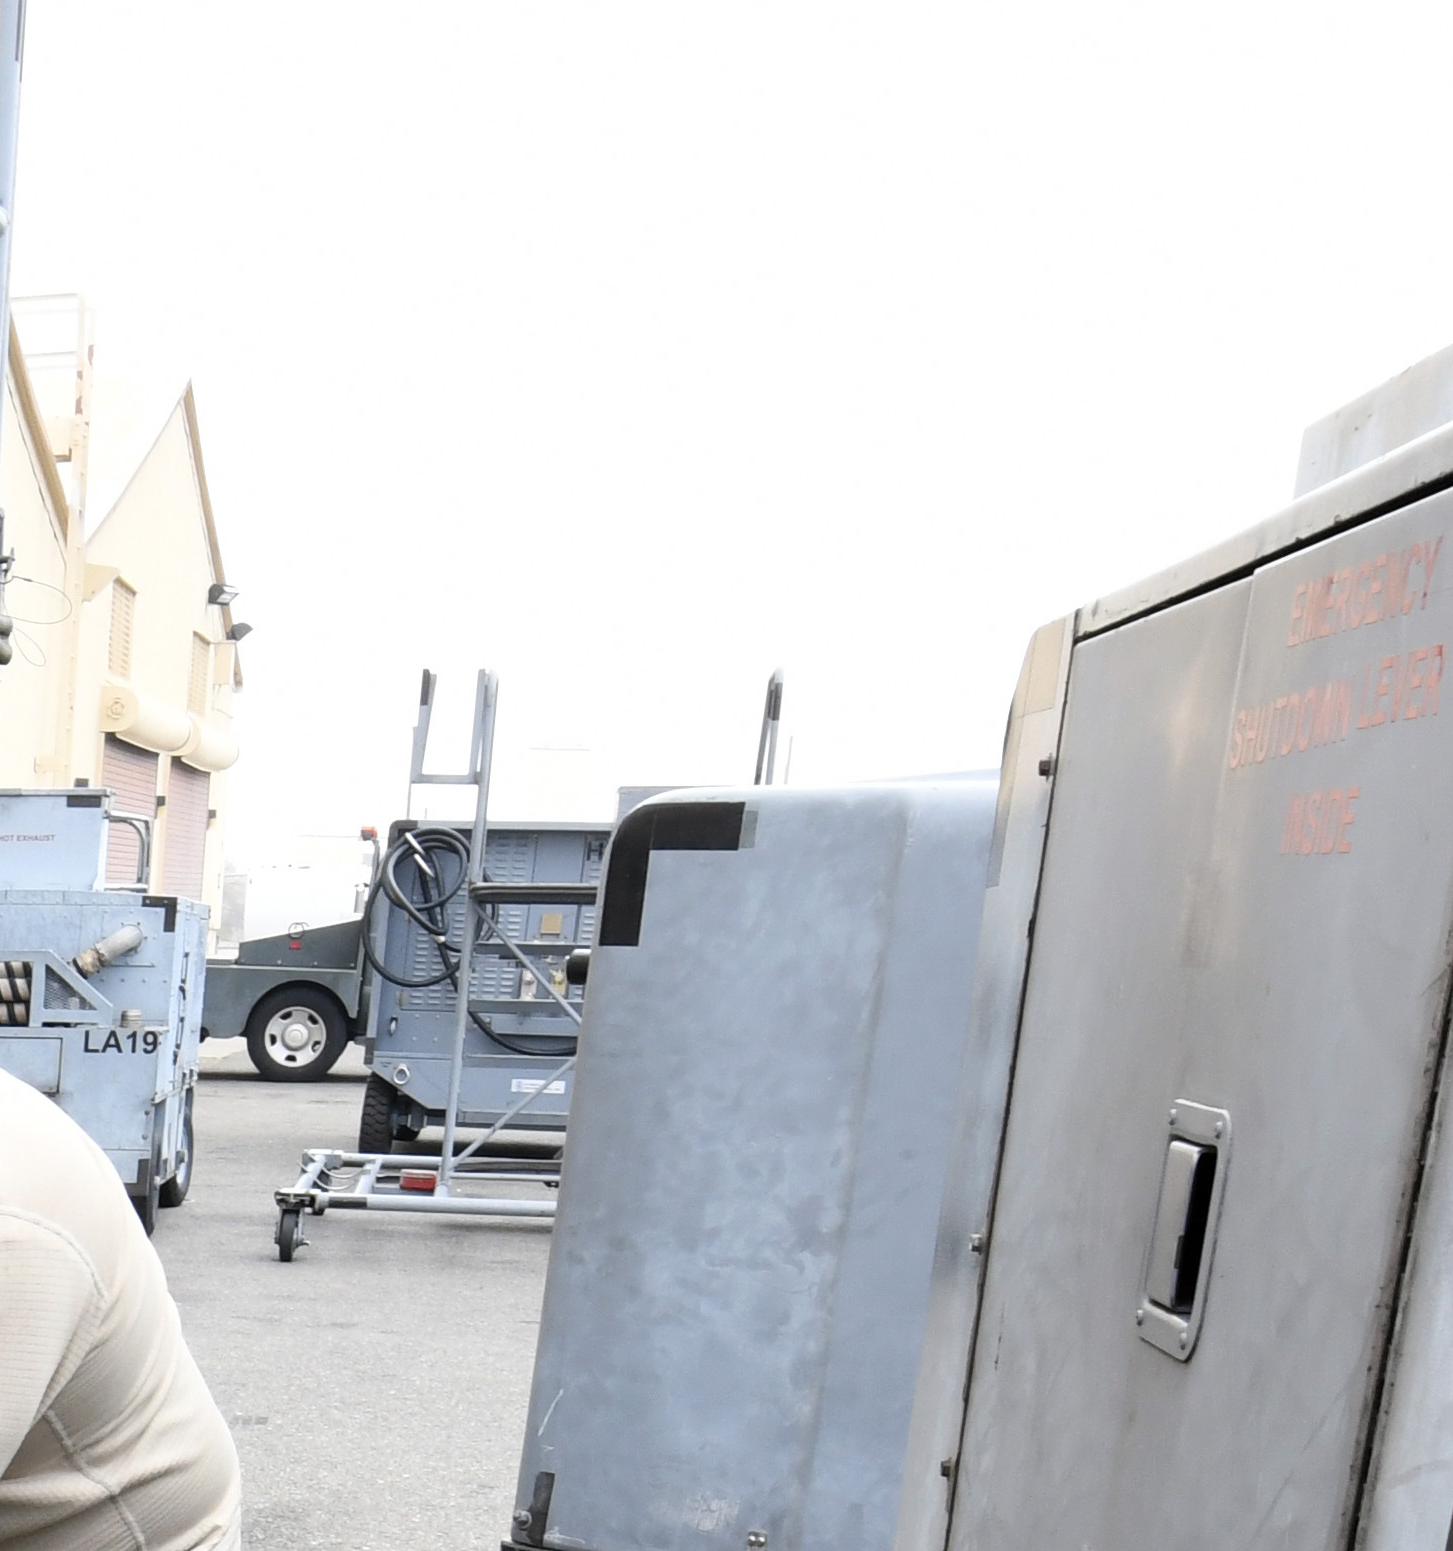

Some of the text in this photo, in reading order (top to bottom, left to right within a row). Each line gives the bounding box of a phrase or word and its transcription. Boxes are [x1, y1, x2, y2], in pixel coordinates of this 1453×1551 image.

[1288, 537, 1443, 647] EMERGENCY
[1230, 644, 1445, 769] SHUTDOWN LEVER
[17, 834, 56, 842] EXHAUST
[1281, 786, 1360, 855] INSIDE
[83, 1029, 159, 1055] LA19
